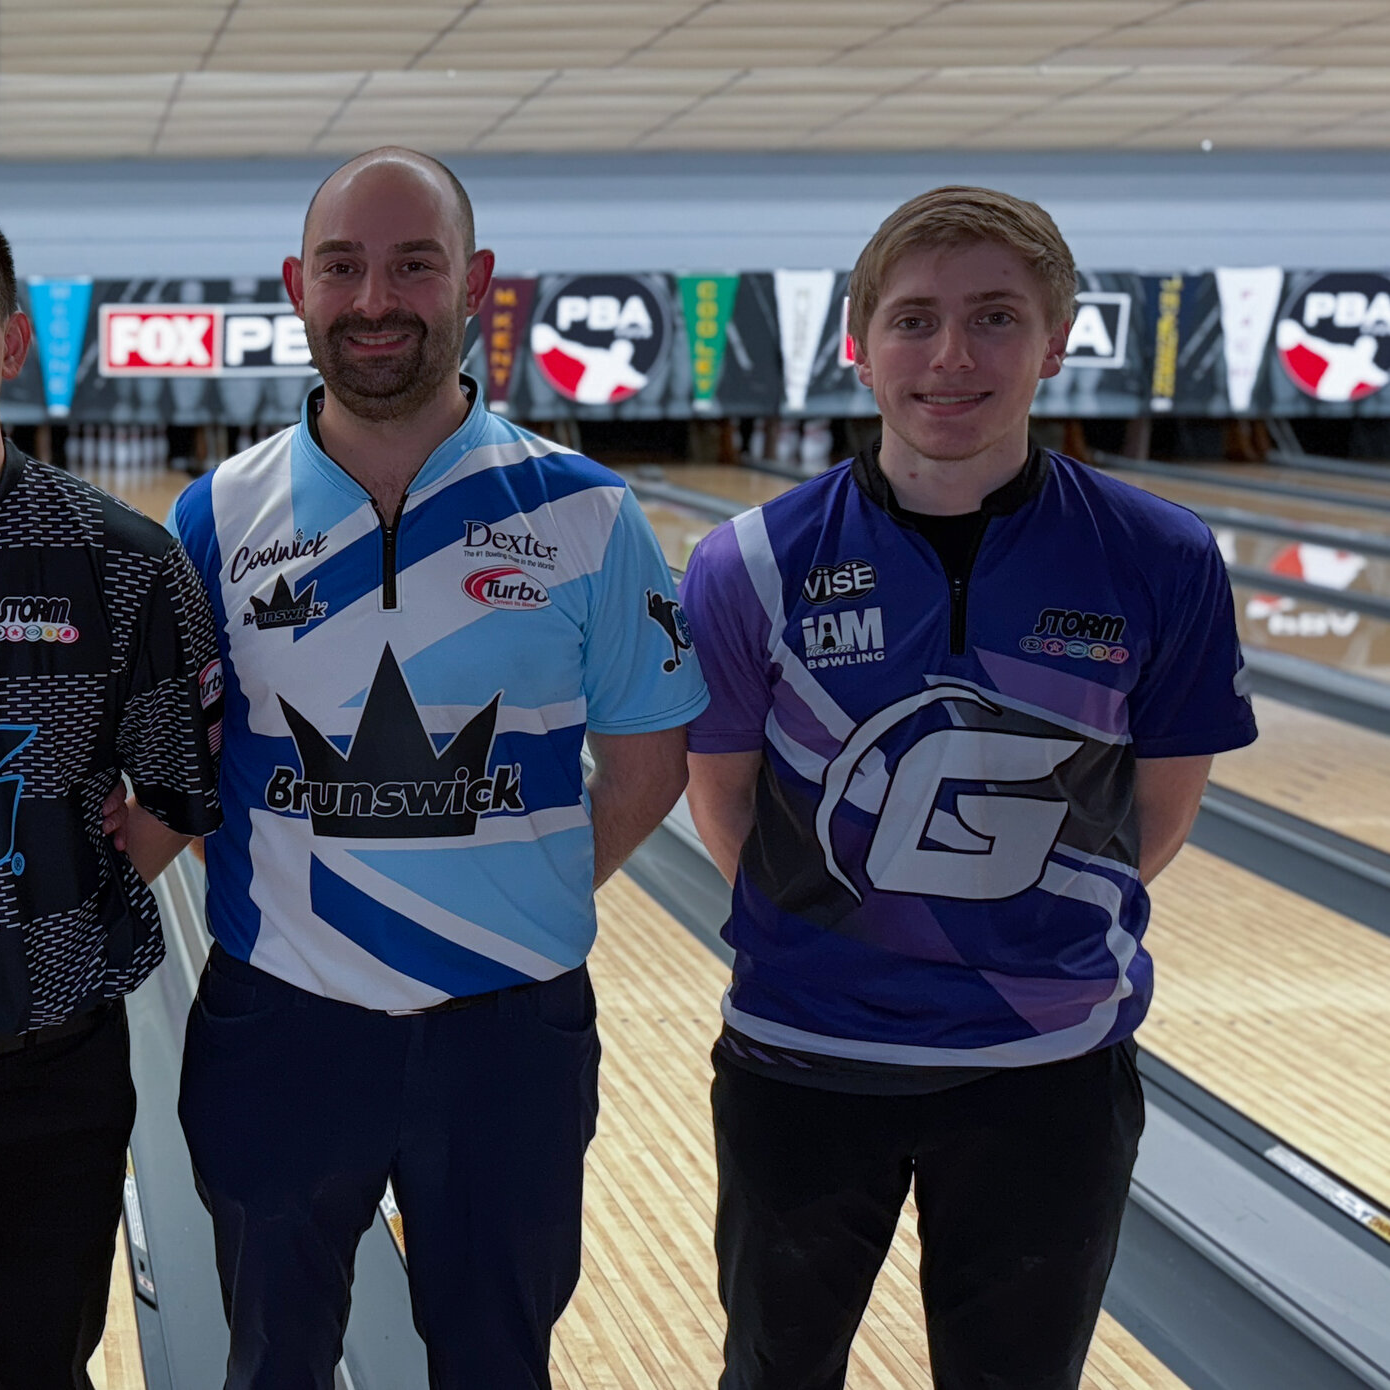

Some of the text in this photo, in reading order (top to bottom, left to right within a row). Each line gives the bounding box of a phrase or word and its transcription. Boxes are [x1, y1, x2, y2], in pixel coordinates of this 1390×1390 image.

[556, 294, 652, 335] PBA
[110, 314, 212, 366] FOX
[231, 528, 328, 583] Coolwick
[463, 521, 558, 562] Dexter
[242, 602, 329, 627] Brunswick
[1033, 608, 1127, 643] STORM
[807, 651, 885, 670] BOWLING
[266, 762, 525, 818] Brunswick
